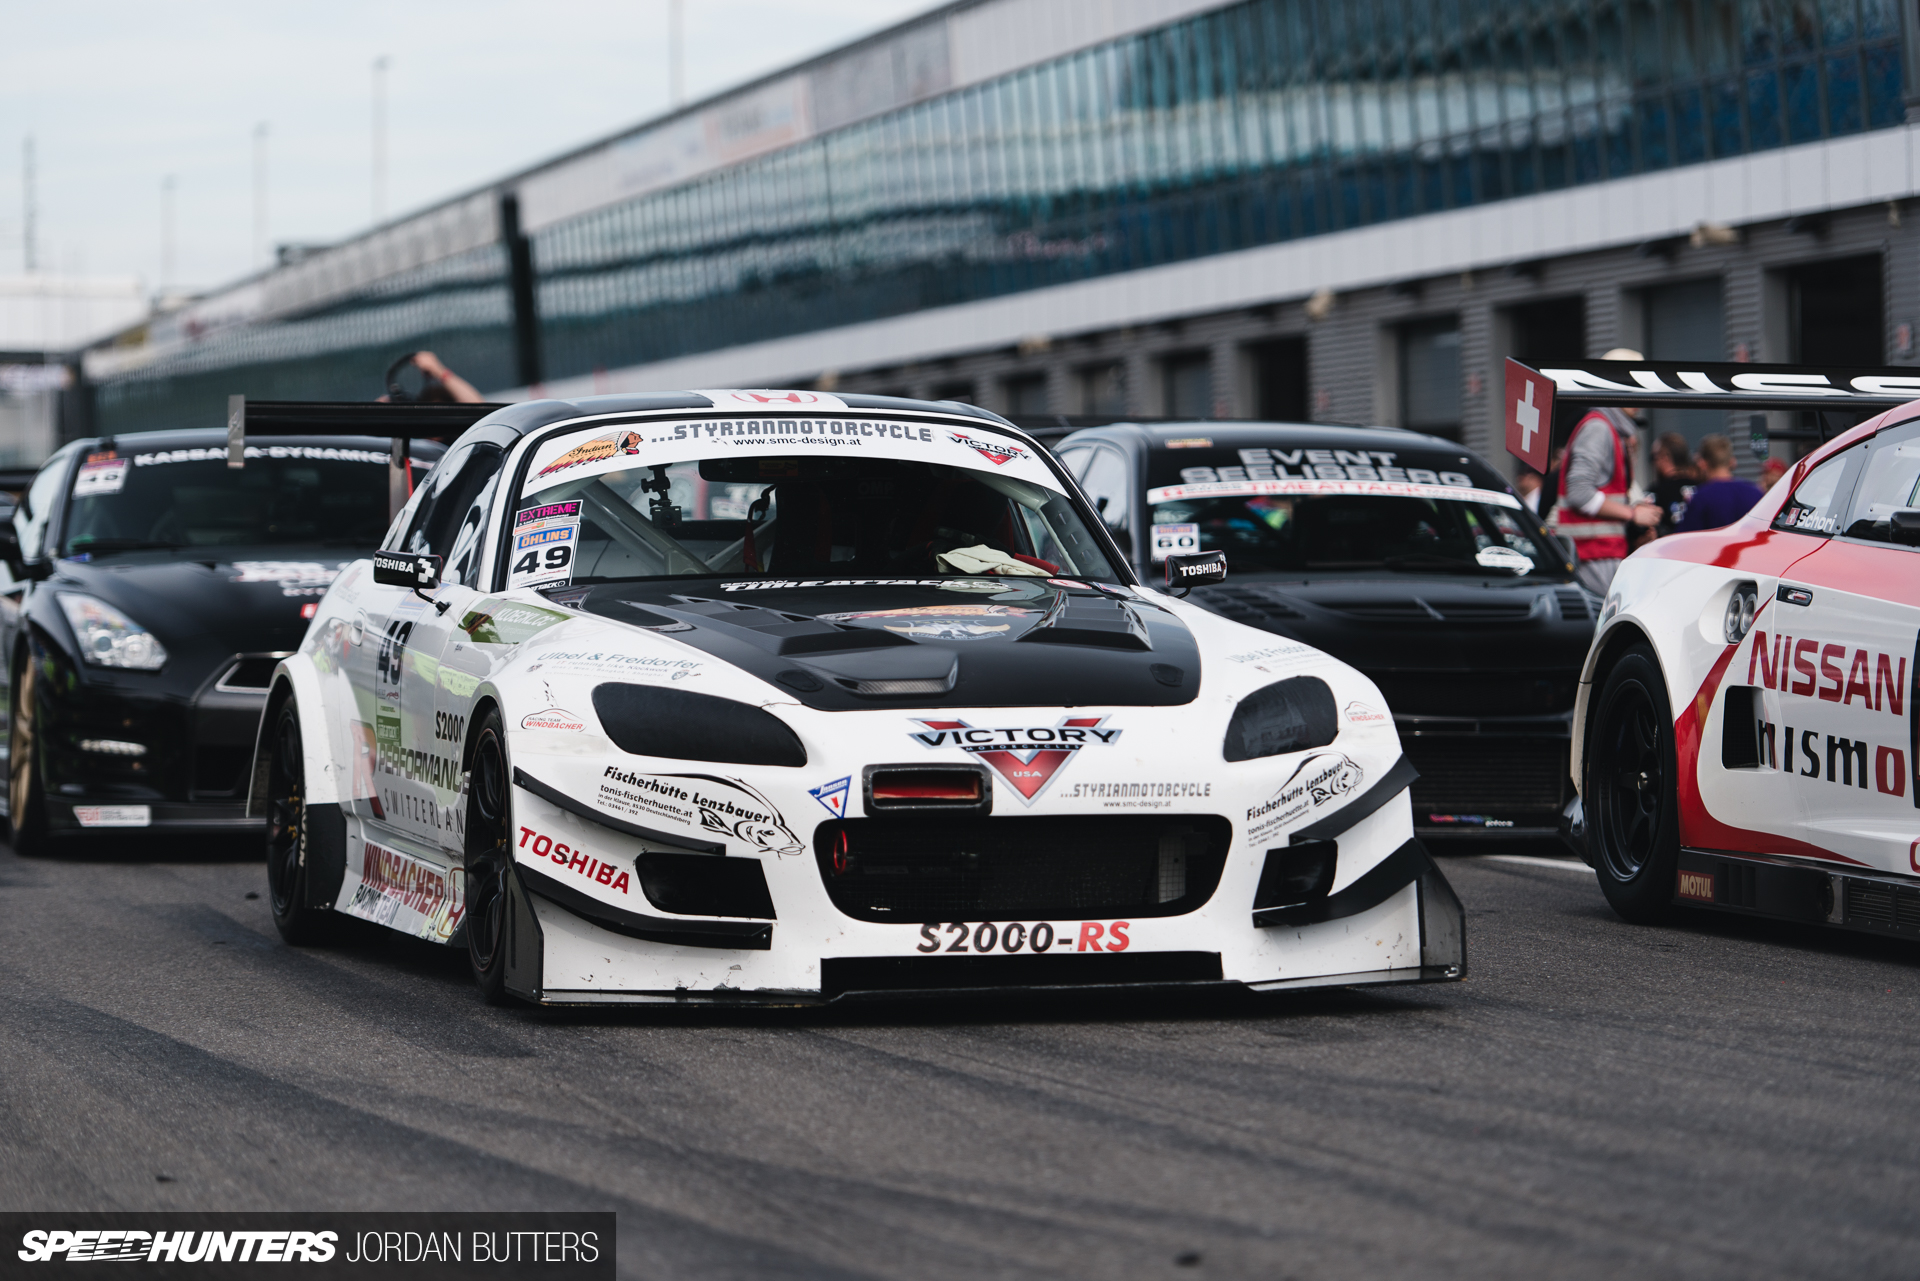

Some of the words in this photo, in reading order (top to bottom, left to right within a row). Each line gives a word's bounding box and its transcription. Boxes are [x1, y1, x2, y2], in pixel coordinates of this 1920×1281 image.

[569, 444, 612, 457] Indian
[733, 436, 862, 446] www.smc-design.at
[947, 436, 1031, 459] VICTORY
[1238, 449, 1397, 466] EVENT
[1180, 464, 1474, 488] SEELISBERG
[520, 503, 578, 522] EXTREME
[1797, 509, 1838, 531] Schori
[521, 530, 570, 547] ÖHLINS
[373, 557, 414, 574] TOSHIBA
[513, 546, 572, 574] 49
[1180, 562, 1222, 576] TOSHIBA
[378, 620, 413, 686] 49
[605, 654, 703, 669] Freidorfer
[1748, 630, 1906, 716] NISSAN
[525, 720, 583, 730] WINDBACHER
[917, 728, 1117, 746] VICTORY
[377, 743, 471, 795] PERFORMANCE
[1758, 719, 1906, 797] nismo
[600, 784, 693, 818] tonis-fischerhuette.at
[603, 766, 688, 801] Fischerhütte
[692, 792, 771, 824] Lenzbauer
[1246, 785, 1303, 821] Fischerhütte
[1306, 761, 1344, 792] Lenzbauer
[384, 788, 465, 834] SWITZERLAN
[608, 802, 624, 812] 03461
[628, 808, 639, 816] 392
[632, 802, 645, 811] 8530
[1103, 799, 1172, 810] www.smc-design.at
[519, 826, 630, 894] TOSHIBA
[1680, 874, 1712, 898] MOTUL
[916, 921, 1130, 953] S2000-RS
